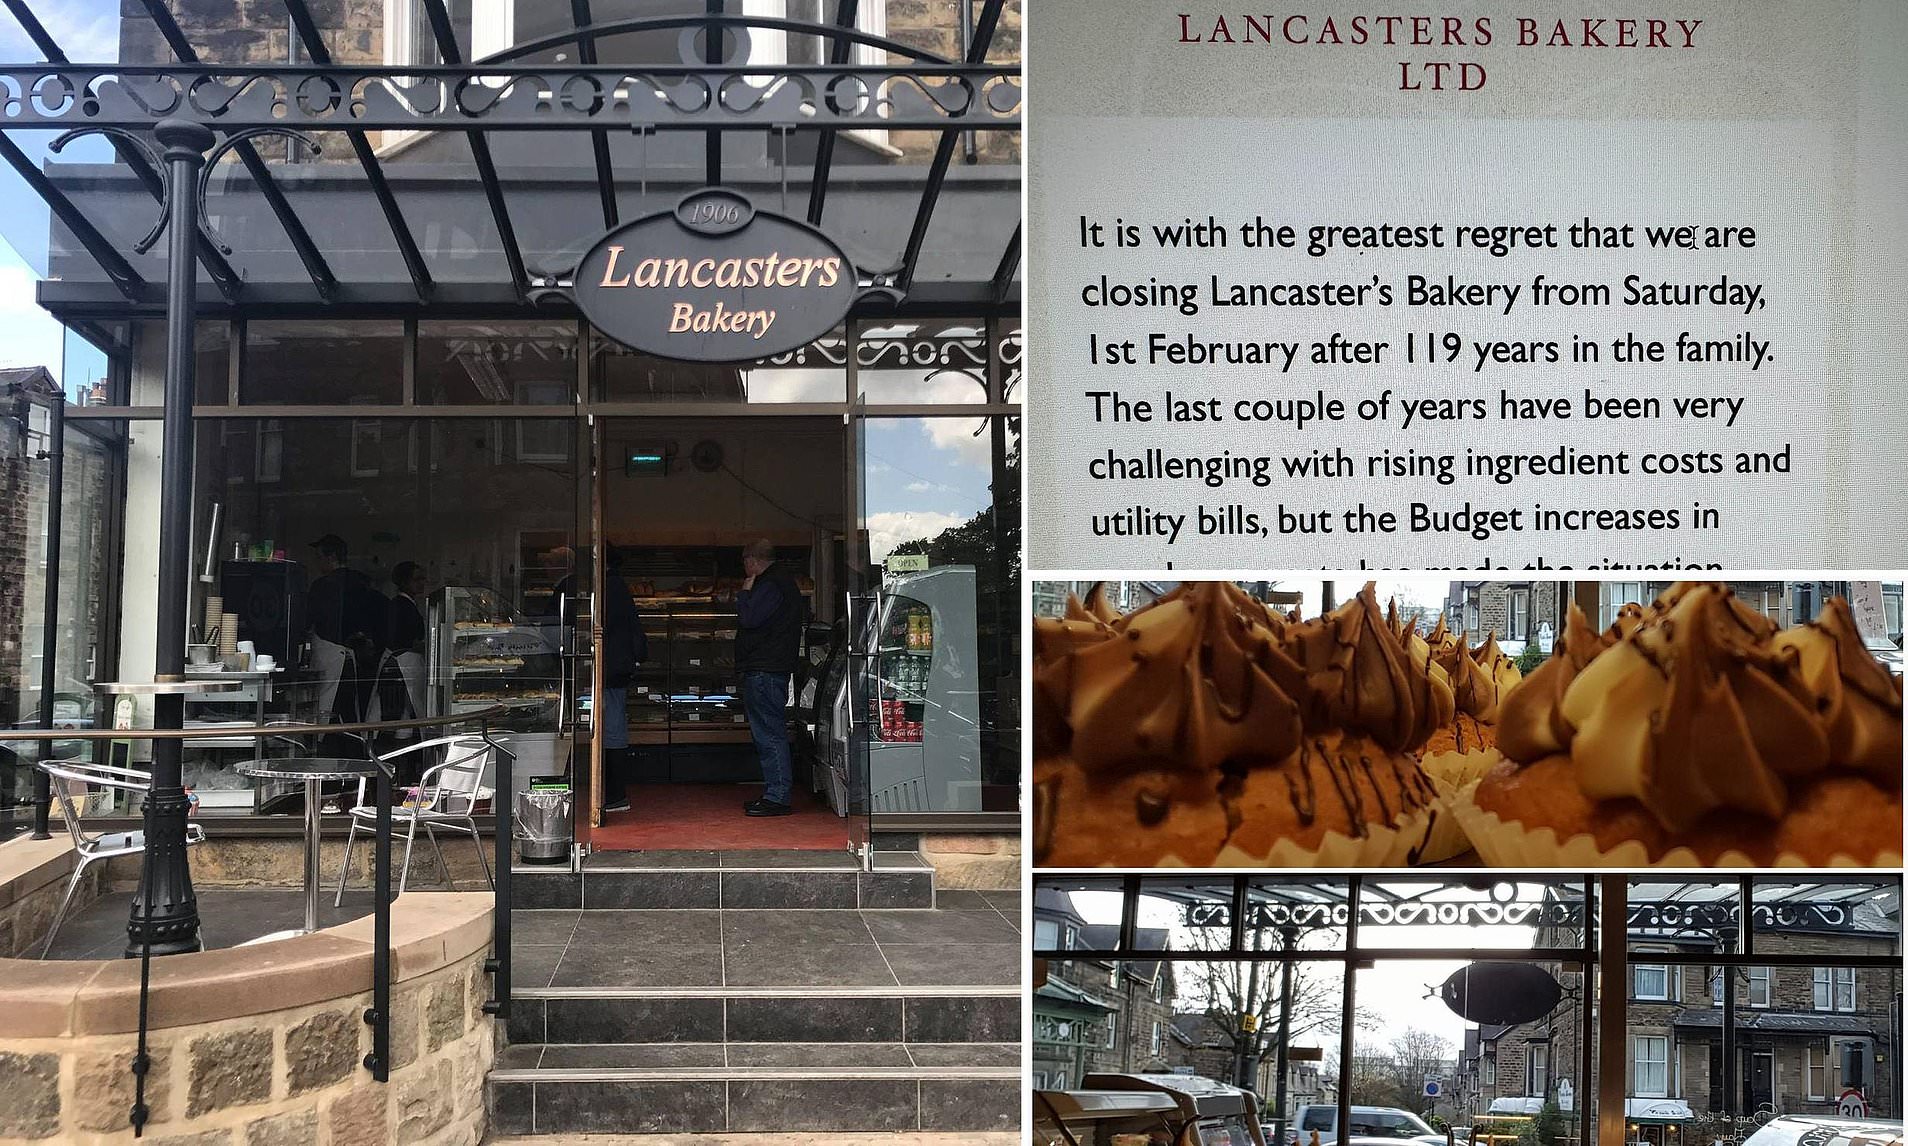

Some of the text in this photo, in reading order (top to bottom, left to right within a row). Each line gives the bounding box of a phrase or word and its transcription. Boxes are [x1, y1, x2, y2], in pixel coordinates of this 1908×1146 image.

[1178, 14, 1706, 49] LANCASTERS BAKERY
[1398, 62, 1489, 92] LTD
[688, 202, 740, 225] 1906
[1080, 215, 1756, 258] It is with the greatest regret that we are
[600, 246, 841, 289] Lancasters
[1081, 276, 1199, 316] closing
[1407, 275, 1522, 316] Bakery
[1532, 275, 1610, 306] from
[1623, 275, 1766, 315] Saturday,
[668, 302, 776, 340] Bakery
[1090, 331, 1774, 373] 1st February after 119 years in the family.
[1085, 388, 1745, 431] The last couple of years have been very
[1089, 443, 1791, 488] challenging with rising ingredient costs and
[1092, 501, 1719, 545] utility bills, but the Budget increases in
[897, 558, 919, 568] OPEN
[1841, 1104, 1863, 1118] 30
